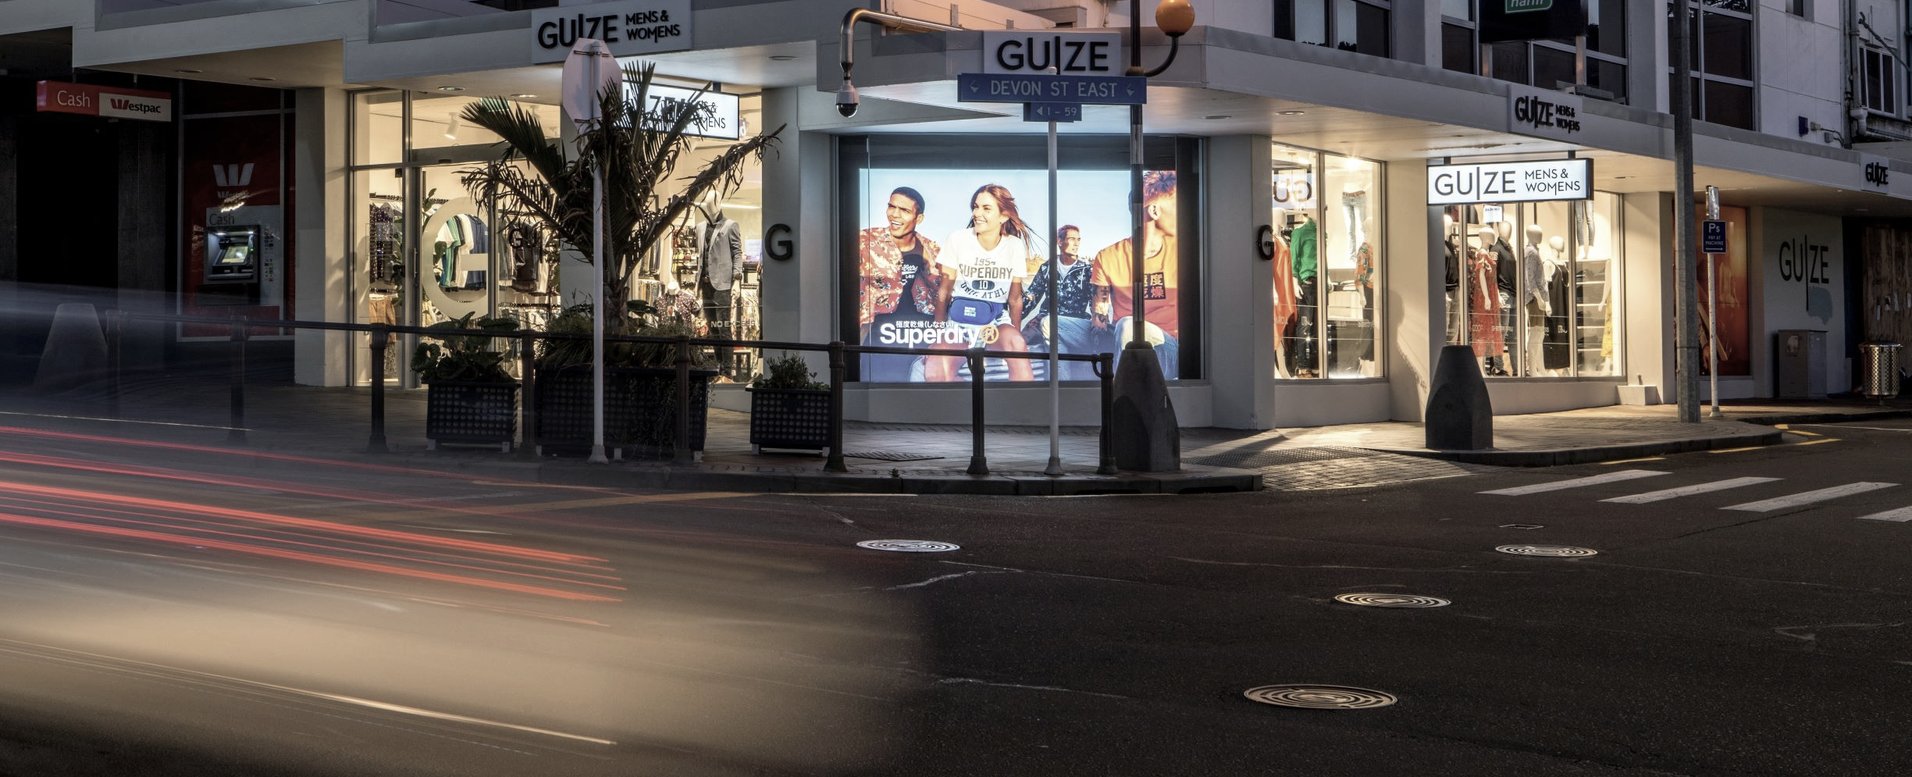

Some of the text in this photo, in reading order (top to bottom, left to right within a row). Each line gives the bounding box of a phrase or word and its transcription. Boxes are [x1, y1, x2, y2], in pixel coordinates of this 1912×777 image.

[625, 9, 669, 26] MENS &
[537, 14, 618, 50] GUIZE
[626, 24, 680, 43] WOMENS
[997, 36, 1109, 75] GUIZE
[57, 90, 91, 108] Cash
[990, 80, 1118, 98] DEVON ST EAST
[110, 98, 161, 114] Westpac
[1064, 106, 1078, 117] 59
[1514, 96, 1554, 129] GUIZE
[1434, 166, 1516, 201] GUIZE
[1524, 168, 1569, 181] MENS &
[1865, 162, 1889, 187] GUIZE
[1525, 180, 1581, 196] WOMENS
[208, 212, 236, 226] Cash
[764, 223, 794, 262] G
[1256, 224, 1275, 261] G
[1779, 234, 1830, 312] GUIZE
[880, 322, 979, 349] Superdry
